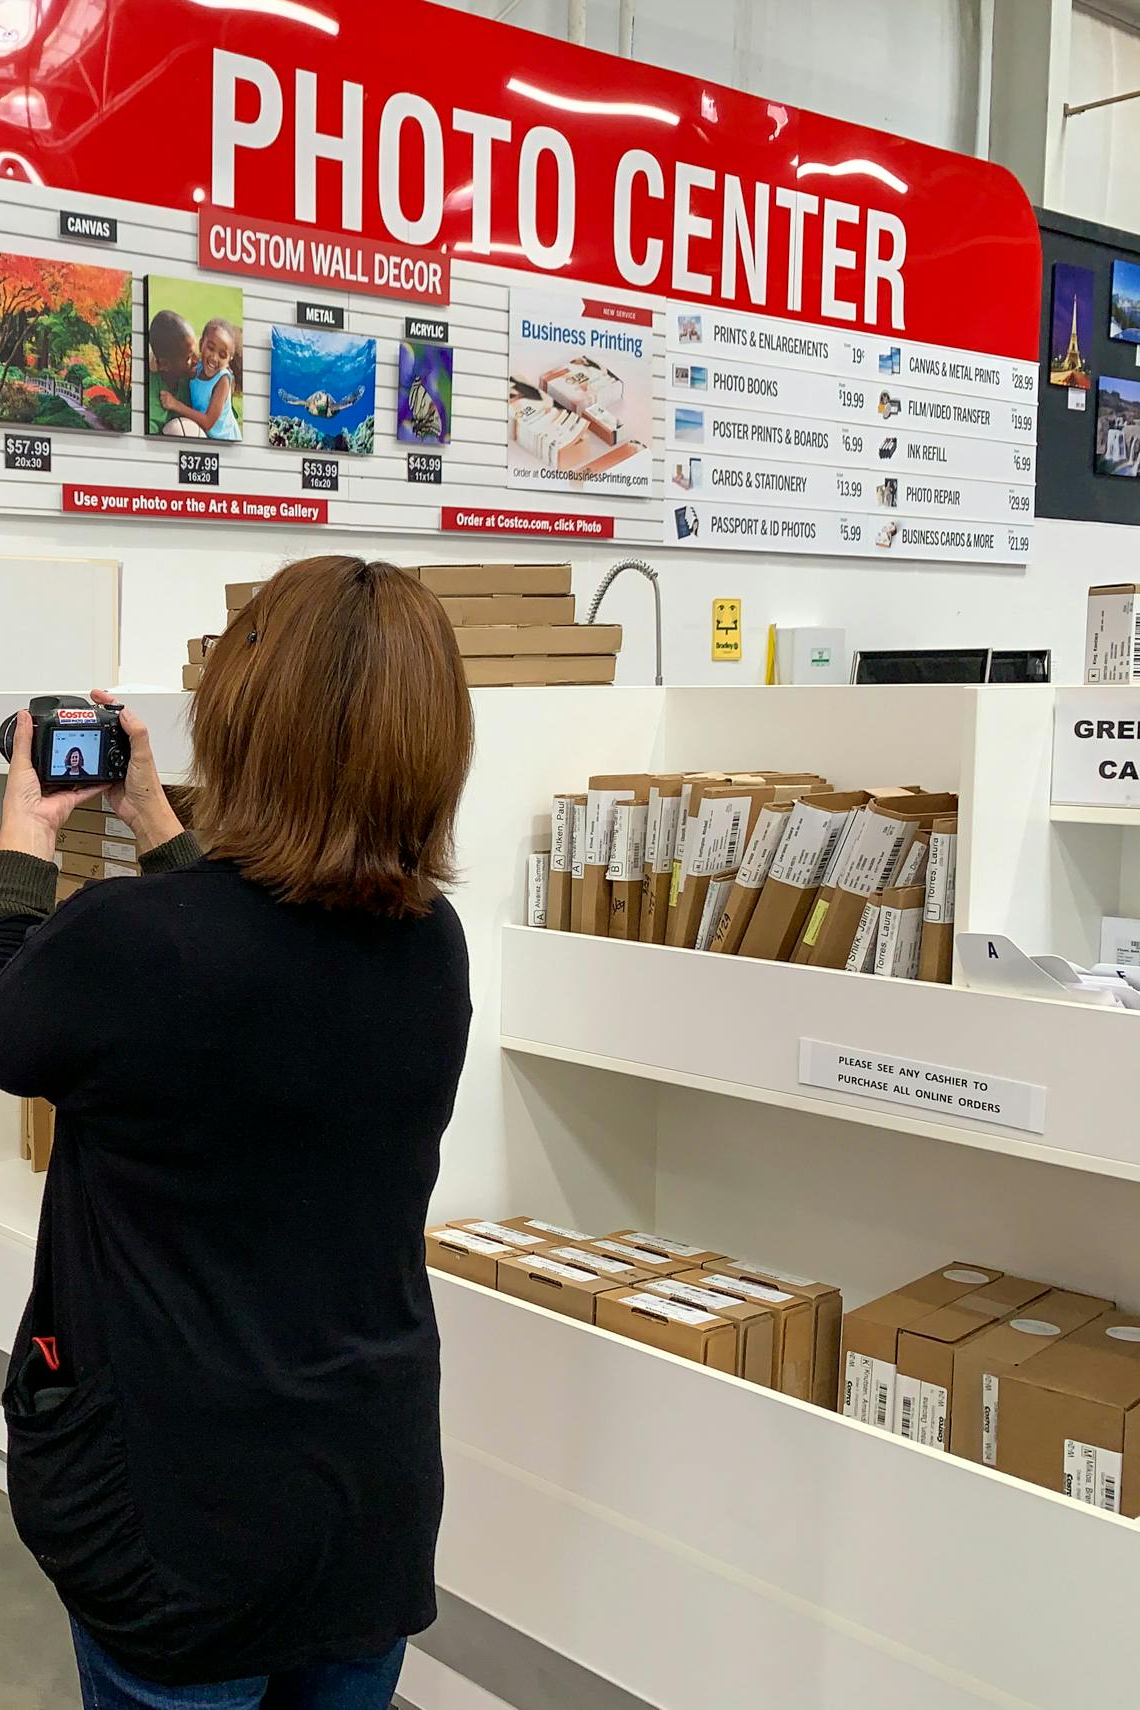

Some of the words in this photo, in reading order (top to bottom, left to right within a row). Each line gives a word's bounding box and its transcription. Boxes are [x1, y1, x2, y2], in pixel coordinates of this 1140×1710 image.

[211, 47, 575, 269] PHOTO
[613, 149, 907, 332] CENTER
[67, 216, 111, 238] CANVAS
[209, 224, 305, 272] CUSTOM
[311, 241, 372, 282] WALL
[374, 252, 443, 296] DECOR
[306, 307, 335, 324] METAL
[410, 322, 444, 338] ACRYLIC
[521, 320, 586, 345] Business
[591, 330, 643, 358] Printing
[713, 325, 747, 346] PRINTS
[749, 331, 756, 348] &
[759, 332, 829, 359] ENLARGEMENTS
[909, 357, 940, 375] CANVAS
[941, 362, 947, 377] &
[949, 362, 973, 381] METAL
[975, 367, 1000, 385] PRINTS
[1012, 373, 1033, 391] $28.99
[713, 372, 745, 393] PHOTO
[747, 377, 778, 397] BOOKS
[839, 390, 864, 409] $19.99
[909, 400, 951, 420] FILM/VIDEO
[953, 406, 990, 425] TRANSFER
[1012, 414, 1032, 431] $19.99
[6, 438, 50, 456] $57.99
[713, 421, 748, 440] POSTER
[751, 425, 783, 444] PRINTS
[784, 428, 792, 445] &
[794, 429, 829, 449] BOARDS
[842, 434, 863, 453] $6.99
[15, 457, 42, 468] 20x30
[180, 455, 218, 471] $37.99
[408, 456, 441, 471] $43.99
[907, 444, 920, 459] INK
[922, 446, 947, 462] REFILL
[1014, 455, 1031, 471] $6.99
[187, 472, 211, 482] 16x20
[303, 462, 337, 477] $53.99
[415, 472, 435, 481] 11x14
[513, 467, 531, 478] Order
[540, 467, 648, 486] CostcoBusinessPrinting.com
[310, 478, 331, 488] 16x20
[712, 468, 743, 488] CARDS
[745, 471, 753, 488] &
[755, 472, 807, 493] STATIONERY
[837, 481, 862, 497] $13.99
[73, 491, 98, 507] Use
[101, 495, 129, 510] your
[132, 495, 167, 512] photo
[171, 500, 183, 511] or
[186, 498, 205, 513] the
[208, 499, 227, 514] Art
[230, 500, 240, 514] &
[243, 501, 277, 517] Image
[279, 503, 319, 520] Gallery
[906, 487, 932, 503] PHOTO
[934, 489, 960, 506] REPAIR
[456, 512, 484, 527] Order
[485, 516, 496, 527] at
[497, 516, 552, 532] Costco.com,
[554, 519, 575, 531] click
[576, 520, 602, 533] Photo
[711, 516, 759, 535] PASSPORT
[760, 519, 768, 536] &
[769, 519, 779, 536] ID
[781, 521, 816, 539] PHOTOS
[840, 525, 861, 542] $5.99
[902, 529, 939, 546] BUSINESS
[940, 531, 965, 547] CARDS
[966, 533, 972, 547] &
[973, 534, 994, 549] MORE
[60, 710, 94, 719] COSTCO
[1074, 720, 1140, 739] GRE
[1099, 760, 1139, 780] CA
[928, 868, 937, 899] Torres,
[881, 910, 892, 937] Laura
[876, 940, 888, 970] Torres,
[988, 941, 999, 958] A
[838, 1055, 873, 1070] PLEASE
[877, 1062, 894, 1074] SEE
[899, 1067, 920, 1079] ANY
[924, 1072, 969, 1089] CASHIER
[973, 1081, 988, 1092] TO
[837, 1073, 888, 1091] PURCHASE
[893, 1085, 910, 1096] ALL
[915, 1088, 953, 1104] ONLINE
[958, 1096, 1001, 1114] ORDERS
